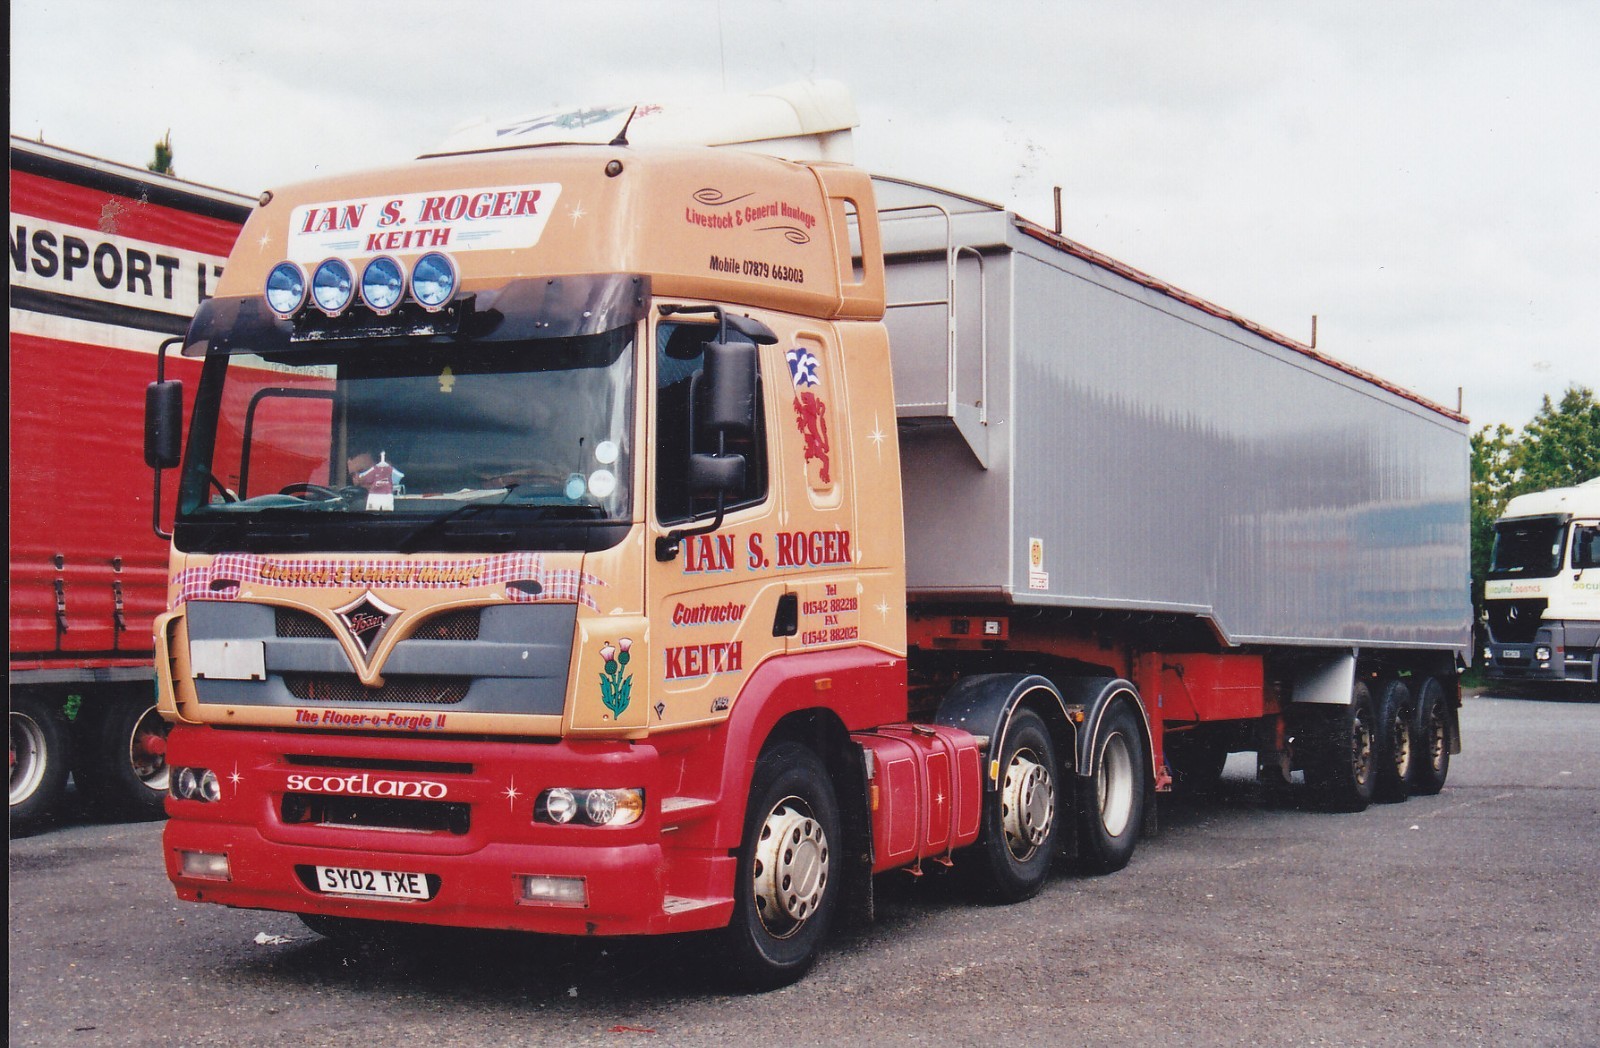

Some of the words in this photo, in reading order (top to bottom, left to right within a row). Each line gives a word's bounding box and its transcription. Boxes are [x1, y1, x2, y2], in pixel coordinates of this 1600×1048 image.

[300, 203, 368, 234] IAN
[379, 199, 407, 228] S.
[417, 189, 542, 222] ROGER
[685, 207, 733, 228] Livestock
[736, 210, 743, 226] &
[745, 201, 778, 222] General
[781, 202, 816, 229] Haulage
[365, 228, 451, 251] KEITH
[710, 255, 740, 274] Mobile
[743, 260, 769, 278] 07879
[772, 265, 804, 283] 663003
[198, 262, 224, 304] L
[682, 534, 735, 574] IAN
[748, 532, 769, 571] S.
[775, 530, 851, 569] ROGER
[350, 566, 413, 584] General
[825, 583, 837, 597] Tel
[672, 601, 746, 627] Contractor
[802, 600, 828, 615] 01542
[830, 597, 858, 613] 882218
[824, 615, 838, 626] FAX
[801, 630, 828, 645] 01542
[829, 626, 858, 642] 882025
[664, 640, 743, 682] KEITH
[295, 709, 319, 725] The
[324, 868, 376, 891] SY02
[381, 871, 421, 895] TXE
